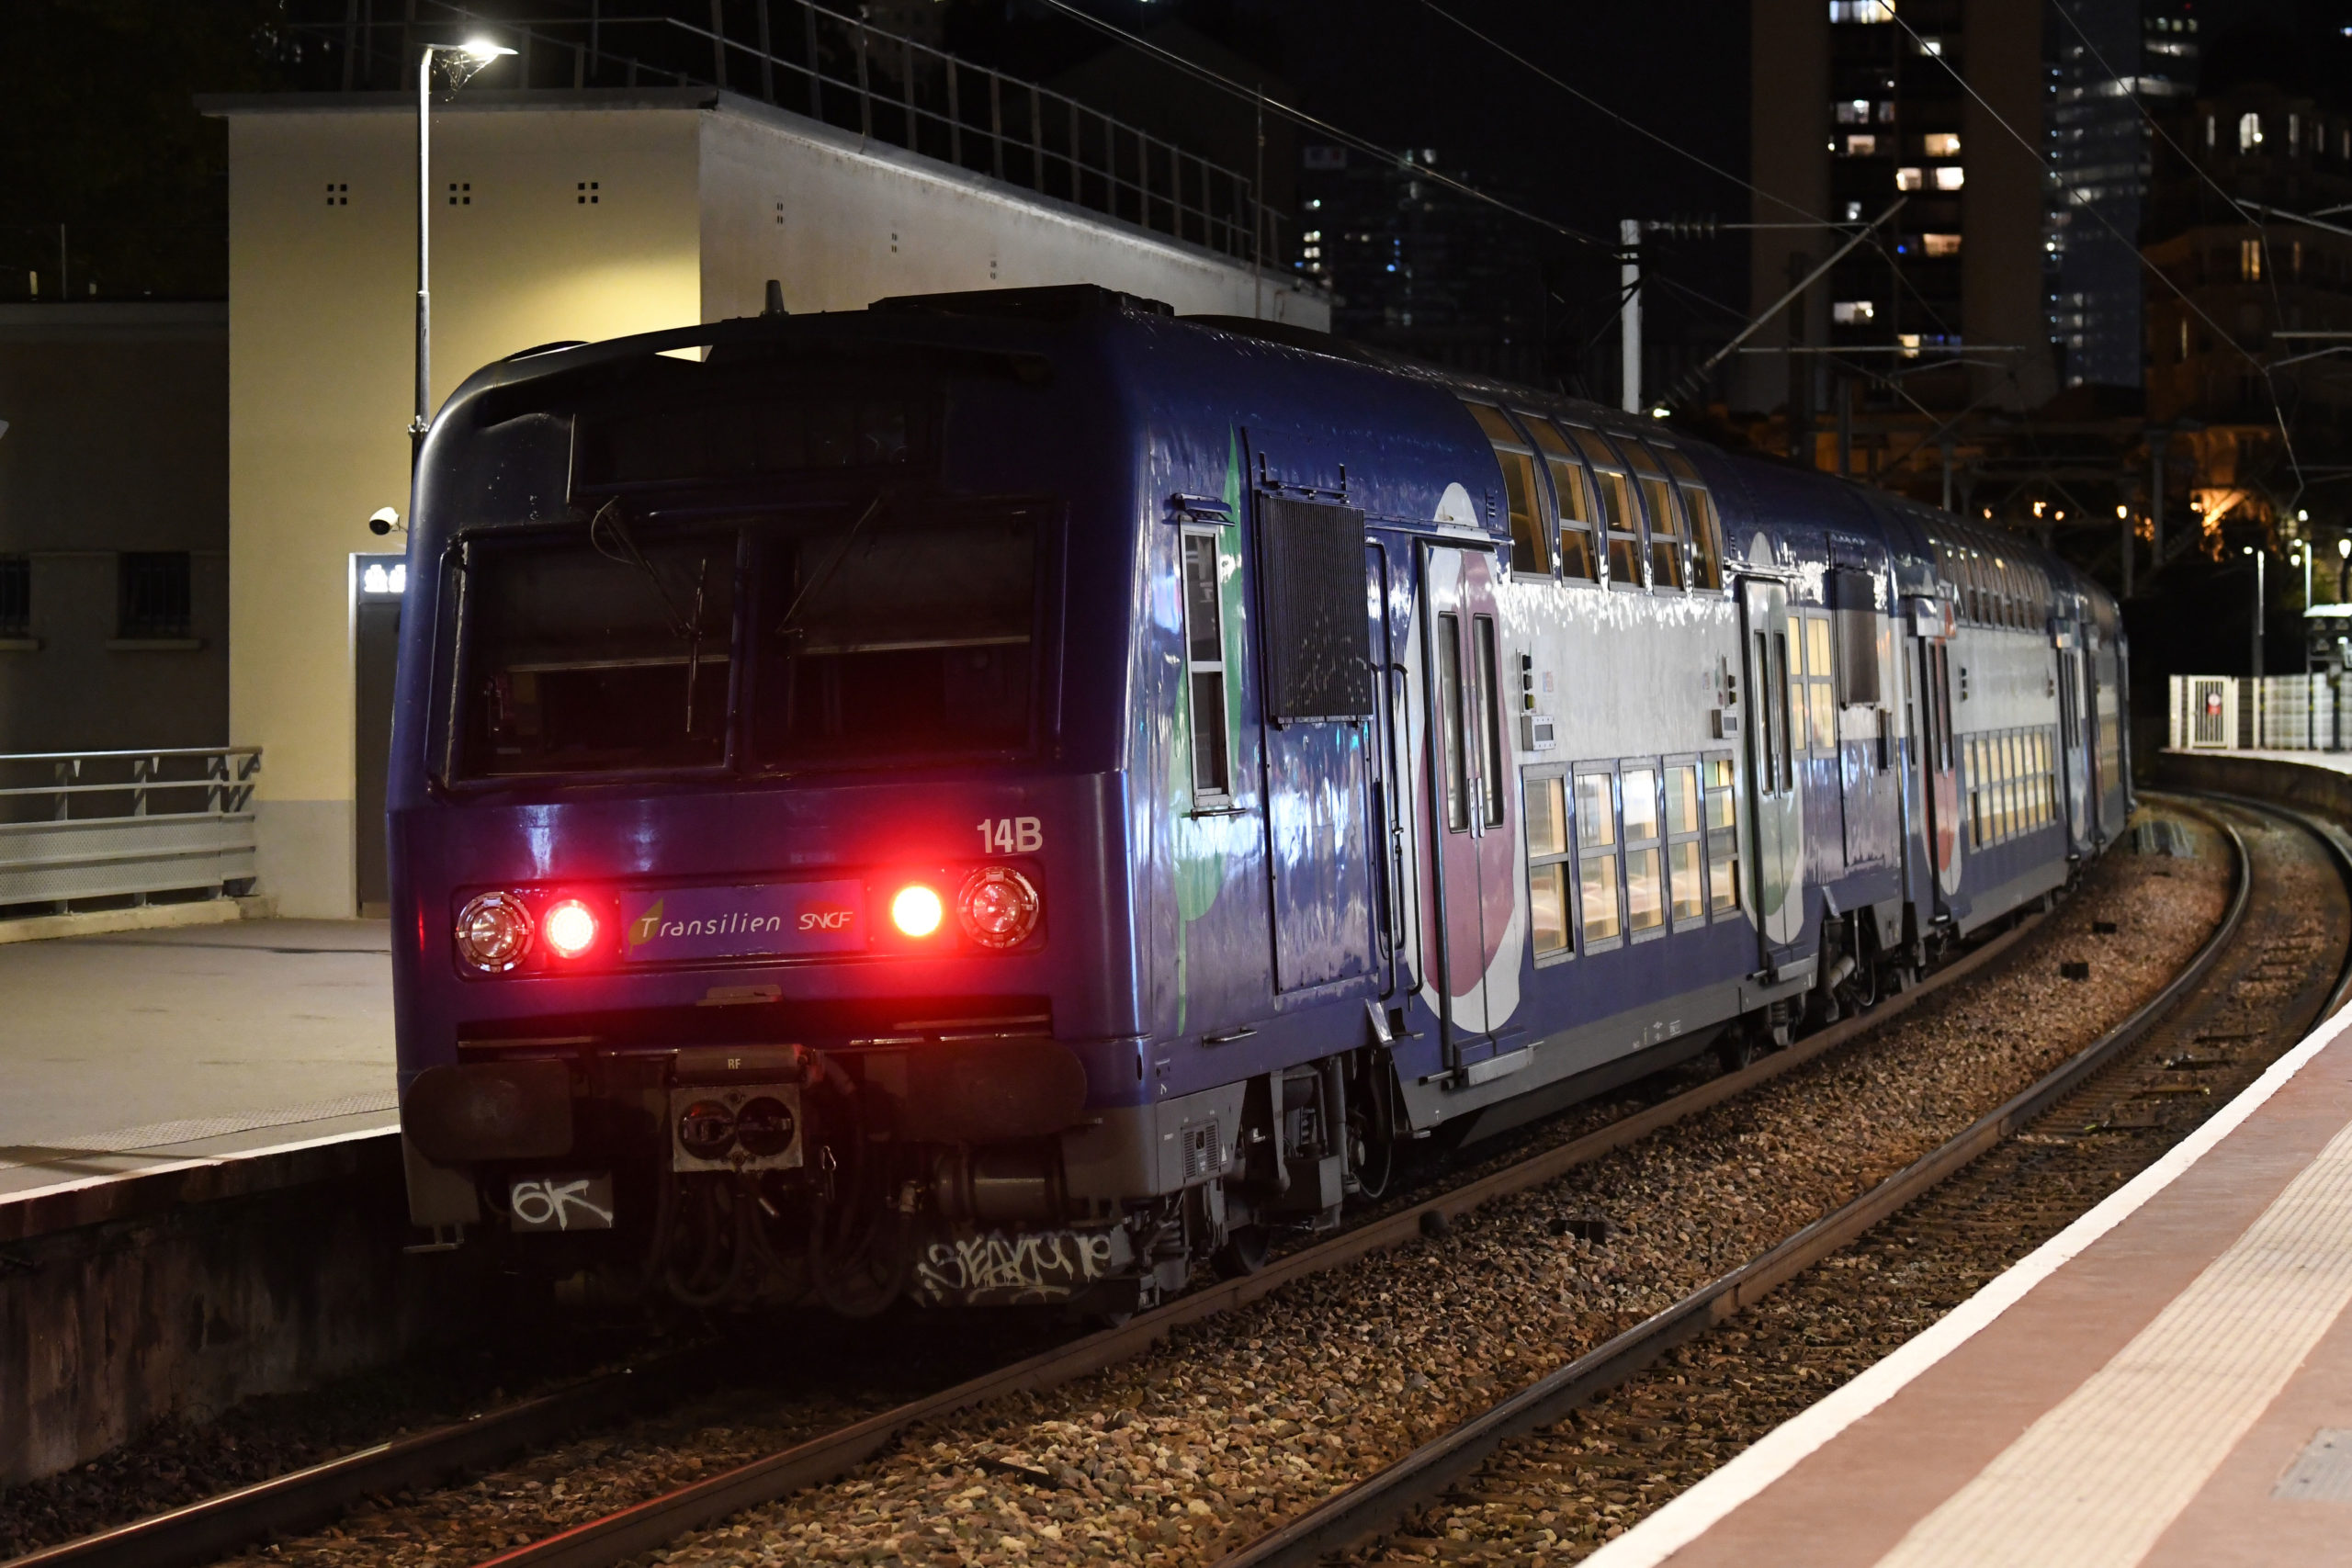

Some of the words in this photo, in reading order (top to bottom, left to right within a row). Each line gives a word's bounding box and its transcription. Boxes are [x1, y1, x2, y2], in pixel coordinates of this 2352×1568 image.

[977, 817, 1043, 853] 14B
[641, 912, 781, 938] Transilien
[798, 911, 854, 931] SNCF
[728, 1058, 741, 1070] RF
